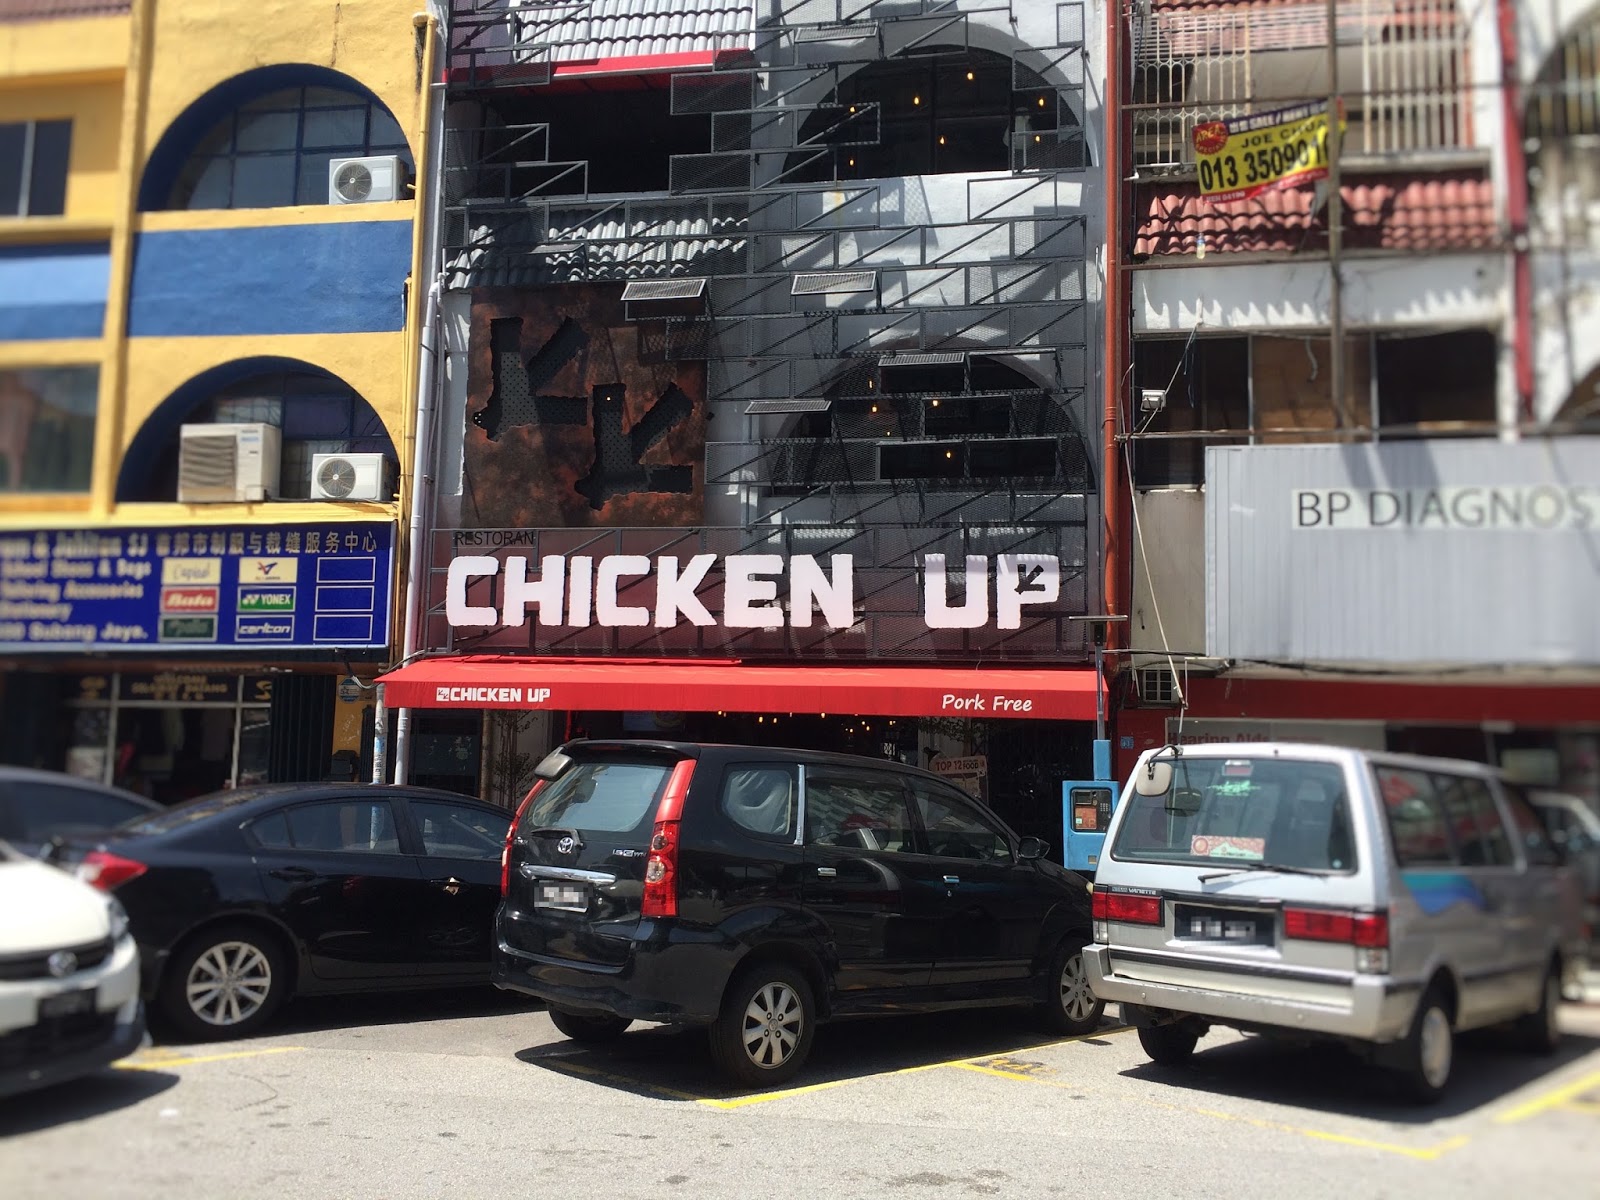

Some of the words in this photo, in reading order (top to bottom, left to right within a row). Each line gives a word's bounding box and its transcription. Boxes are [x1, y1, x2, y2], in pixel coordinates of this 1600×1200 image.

[1196, 124, 1223, 144] AREA
[1241, 134, 1273, 148] JOE
[1200, 155, 1238, 190] 013
[1298, 491, 1350, 526] BP
[454, 531, 534, 546] RESTORAN
[446, 554, 854, 628] CHICKEN
[923, 554, 1060, 629] UP
[260, 594, 291, 605] YONEX
[238, 622, 291, 634] carlton
[450, 687, 522, 702] CHICKEN
[527, 688, 551, 702] UP
[941, 693, 984, 711] Pork
[992, 696, 1033, 712] Free
[935, 761, 951, 771] TOP
[954, 760, 962, 770] 12
[963, 762, 979, 770] FOOD
